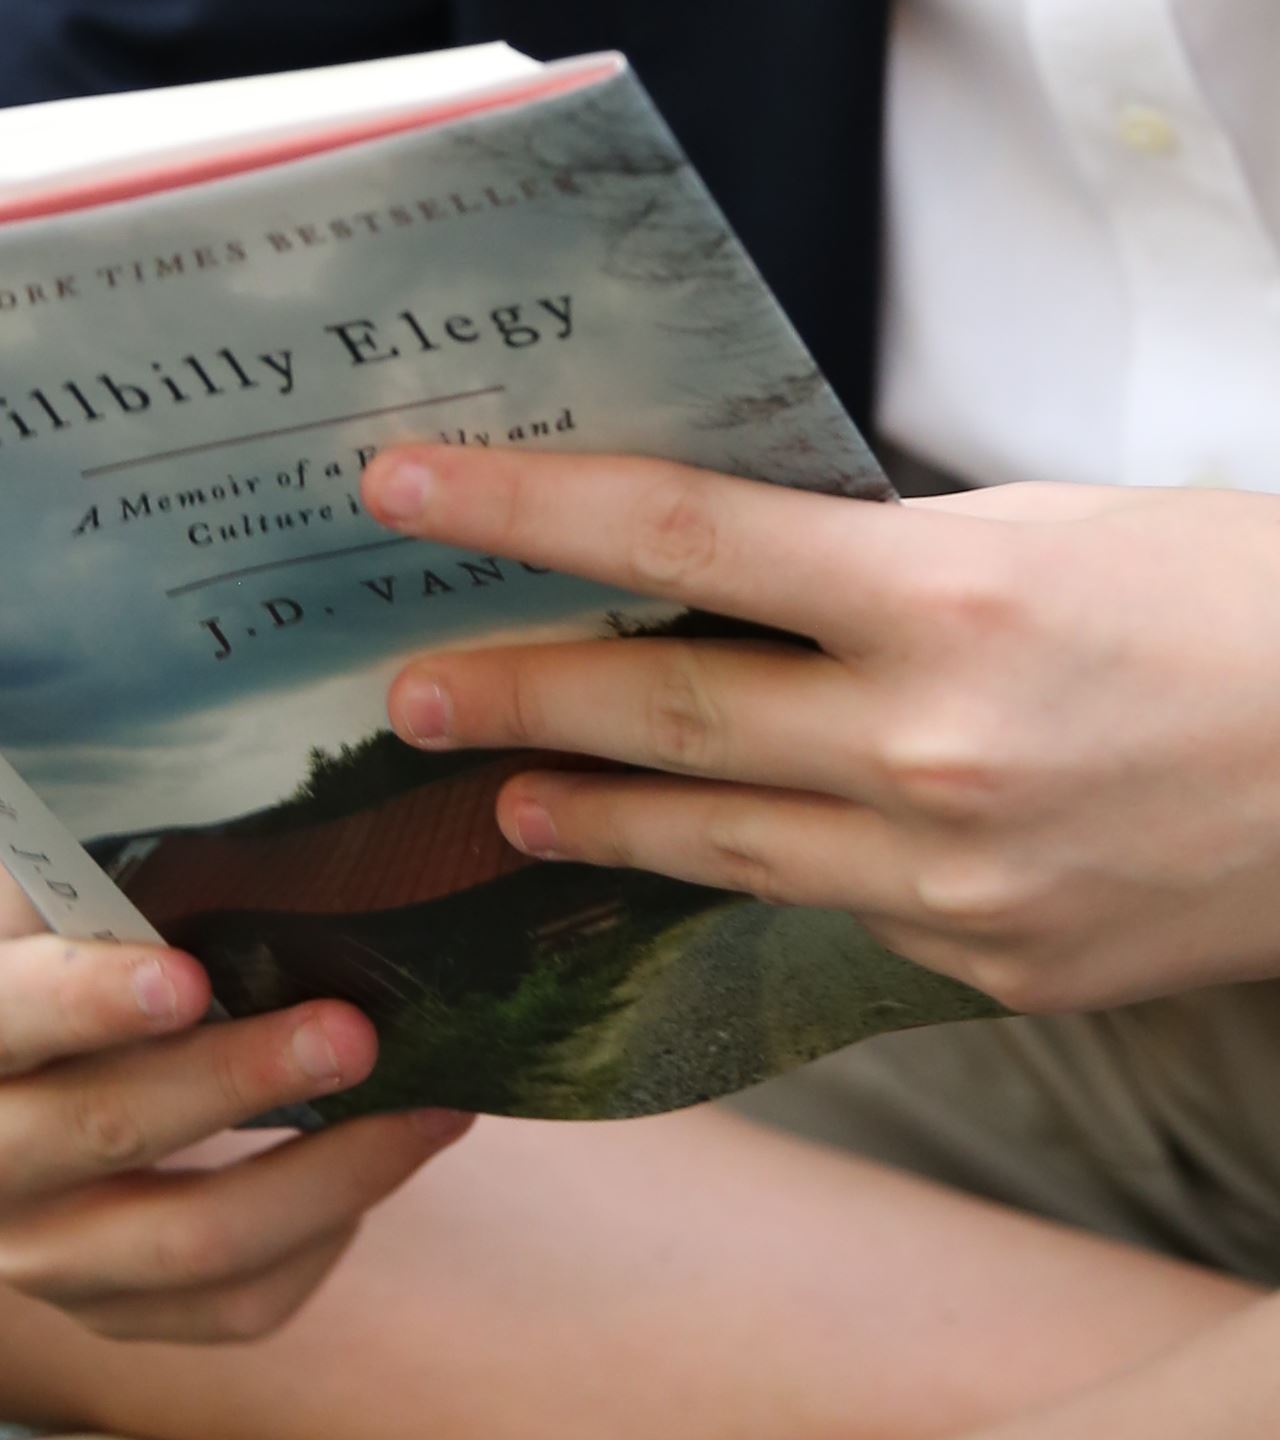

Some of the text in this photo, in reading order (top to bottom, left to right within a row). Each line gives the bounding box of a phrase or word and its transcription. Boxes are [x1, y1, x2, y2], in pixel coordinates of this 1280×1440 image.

[97, 240, 247, 288] TIMES
[266, 169, 582, 254] BESTSELLER
[324, 294, 574, 367] Elegy
[72, 504, 101, 537] A
[119, 470, 261, 522] Memoir
[277, 458, 312, 489] of
[324, 461, 343, 479] a
[507, 408, 576, 441] and
[187, 502, 336, 548] Culture
[200, 556, 552, 661] J.D. VAN
